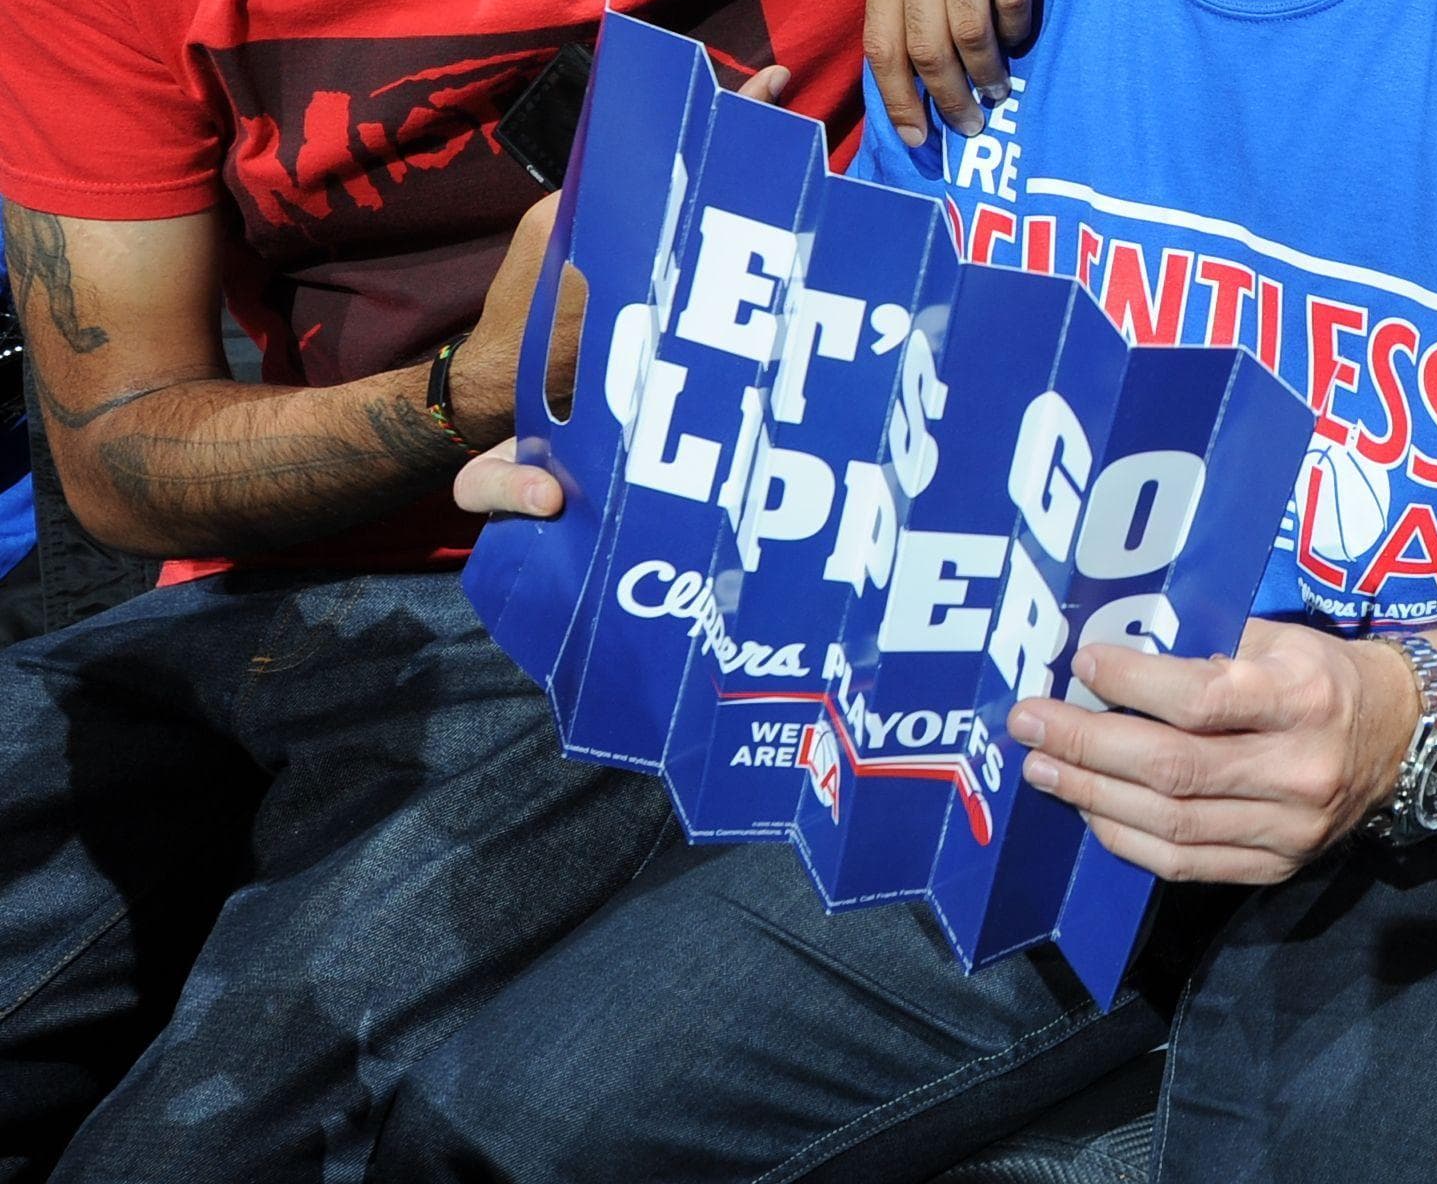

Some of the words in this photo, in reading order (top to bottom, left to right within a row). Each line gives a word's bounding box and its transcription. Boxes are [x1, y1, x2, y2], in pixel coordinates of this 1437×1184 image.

[942, 124, 1022, 203] RE
[1007, 390, 1206, 580] GO
[616, 559, 811, 678] Clippers
[730, 746, 798, 767] ARE
[751, 721, 800, 744] WE
